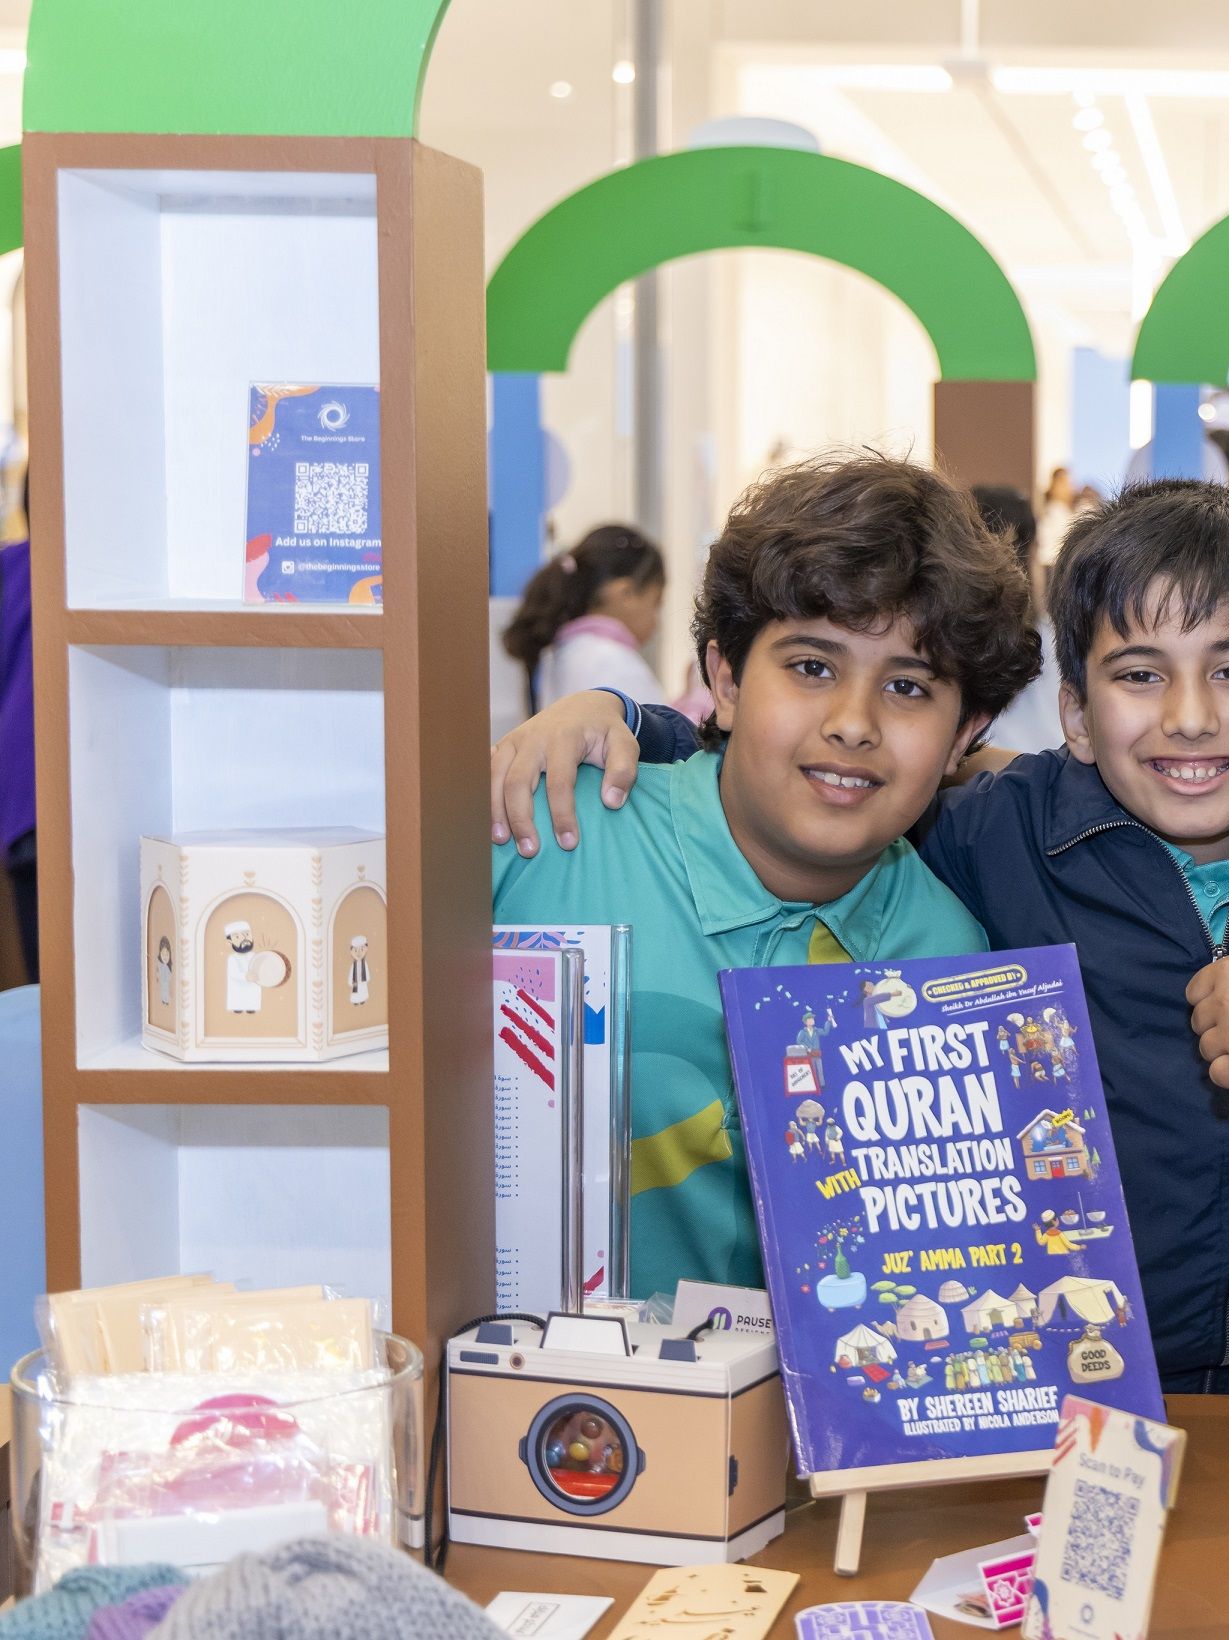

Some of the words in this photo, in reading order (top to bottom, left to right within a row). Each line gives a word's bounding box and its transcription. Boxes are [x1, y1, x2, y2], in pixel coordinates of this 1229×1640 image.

[313, 435, 347, 444] Beginnings
[275, 537, 297, 547] Add
[299, 539, 311, 548] us
[313, 539, 327, 548] on
[329, 537, 381, 550] Instagram
[932, 981, 965, 996] CHECKED
[970, 973, 1007, 988] APPROVED
[974, 992, 1006, 1006] Abdullah
[839, 1033, 885, 1075] MY
[888, 1021, 990, 1073] FIRST
[842, 1072, 1004, 1142] QURAN
[851, 1137, 1014, 1180] TRANSLATION
[815, 1167, 862, 1200] WITH
[860, 1173, 1027, 1234] PICTURES
[920, 1246, 967, 1271] AMMA
[969, 1245, 1007, 1269] PART
[1010, 1242, 1024, 1265] 2
[737, 1315, 772, 1328] PAUSE
[1080, 1348, 1107, 1362] GOOD
[1081, 1360, 1111, 1373] DEEDS
[898, 1398, 921, 1422] BY
[925, 1391, 995, 1417] SHEREEN
[998, 1385, 1059, 1412] SHARIEF
[903, 1415, 961, 1436] ILLUSTRATED
[963, 1414, 977, 1431] BY
[979, 1413, 1010, 1430] NICOLA
[1012, 1408, 1060, 1427] ANDERSON
[1079, 1453, 1107, 1477] Scan
[1109, 1461, 1121, 1478] to
[1123, 1465, 1146, 1489] Pay
